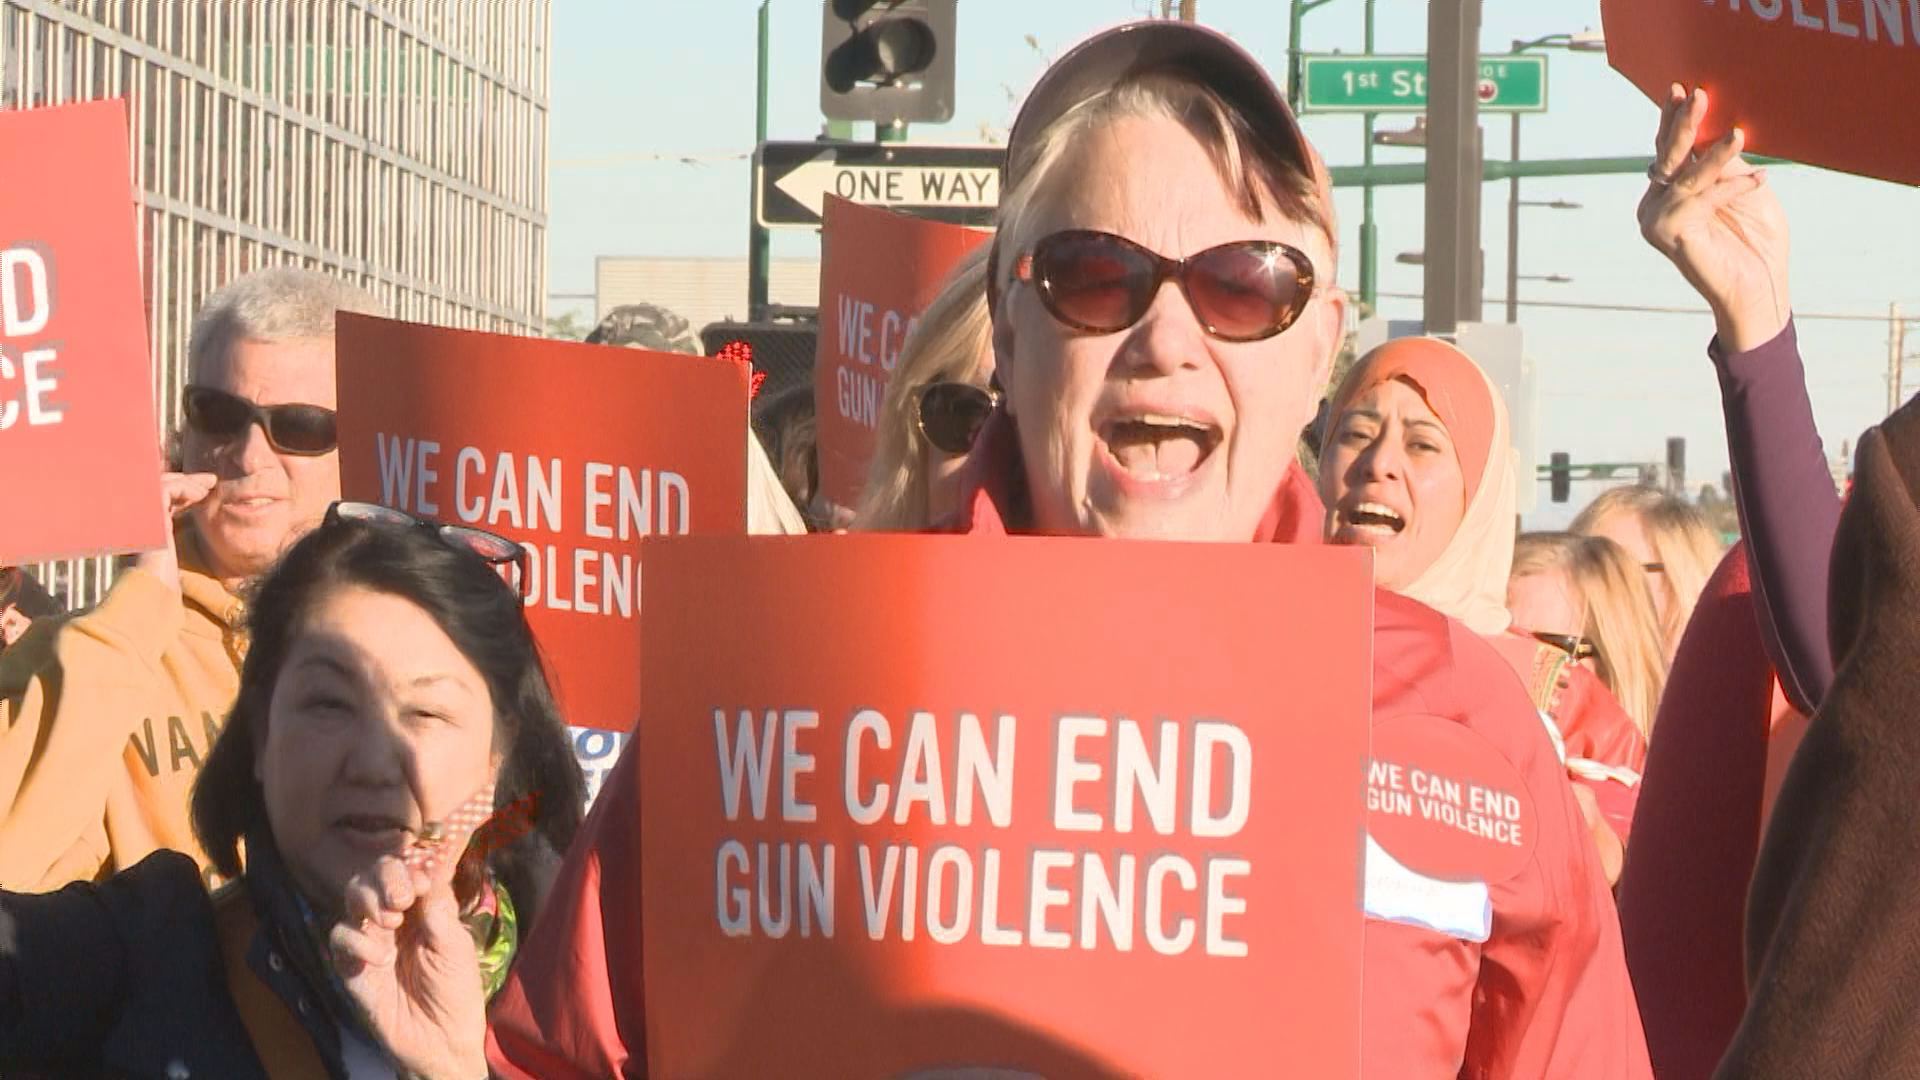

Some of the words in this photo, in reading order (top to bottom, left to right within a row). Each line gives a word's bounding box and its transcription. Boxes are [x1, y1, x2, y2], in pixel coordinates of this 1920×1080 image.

[1342, 71, 1378, 96] 1st
[1392, 70, 1425, 96] St
[835, 170, 904, 201] ONE
[920, 171, 991, 201] WAY
[837, 293, 873, 364] WE
[836, 365, 876, 431] GUN
[377, 432, 440, 515] WE
[455, 446, 562, 532] CAN
[585, 462, 690, 541] END
[496, 542, 642, 618] OLEN
[714, 709, 819, 822] WE
[845, 709, 1017, 828] CAN
[1054, 716, 1253, 838] END
[1367, 760, 1403, 790] WE
[1410, 769, 1461, 807] CAN
[1468, 785, 1520, 821] END
[1367, 787, 1412, 816] GUN
[1417, 798, 1523, 846] VIOLENCE
[716, 840, 835, 939] GUN
[858, 844, 1252, 958] VIOLENCE
